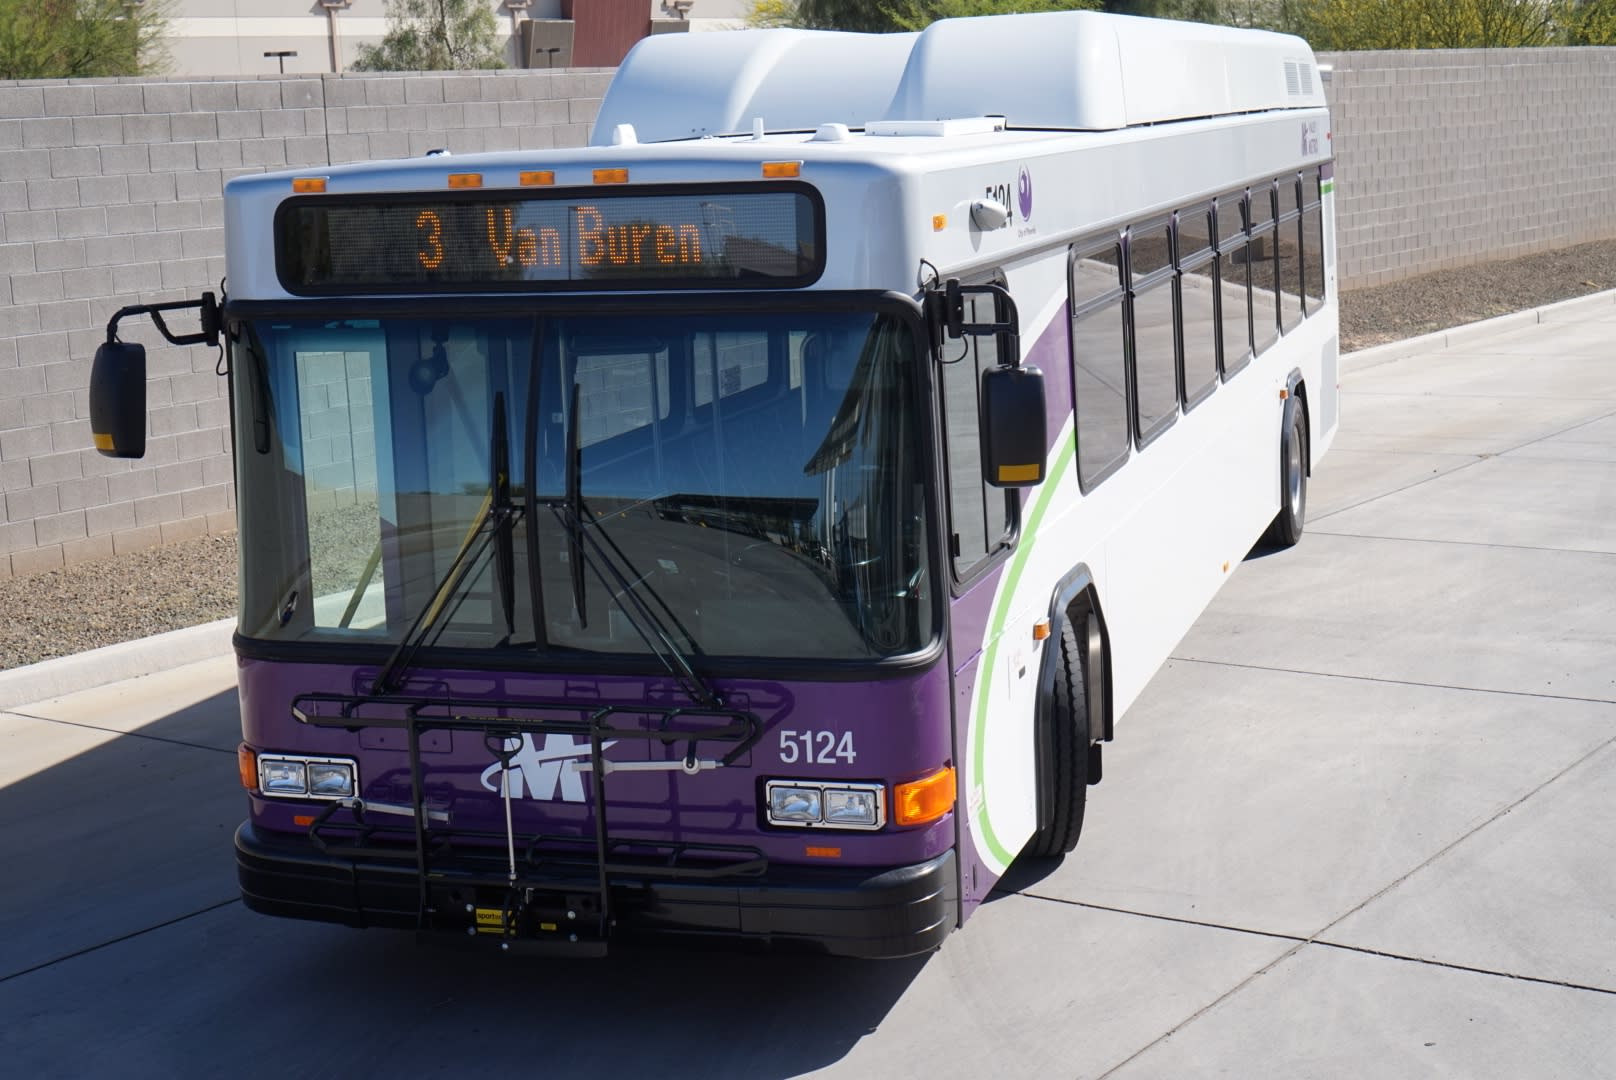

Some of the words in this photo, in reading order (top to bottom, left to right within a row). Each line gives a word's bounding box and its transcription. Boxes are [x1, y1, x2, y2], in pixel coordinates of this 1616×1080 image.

[416, 210, 443, 269] 3
[487, 207, 561, 268] Van
[577, 206, 701, 264] Buren
[779, 730, 857, 764] 5124
